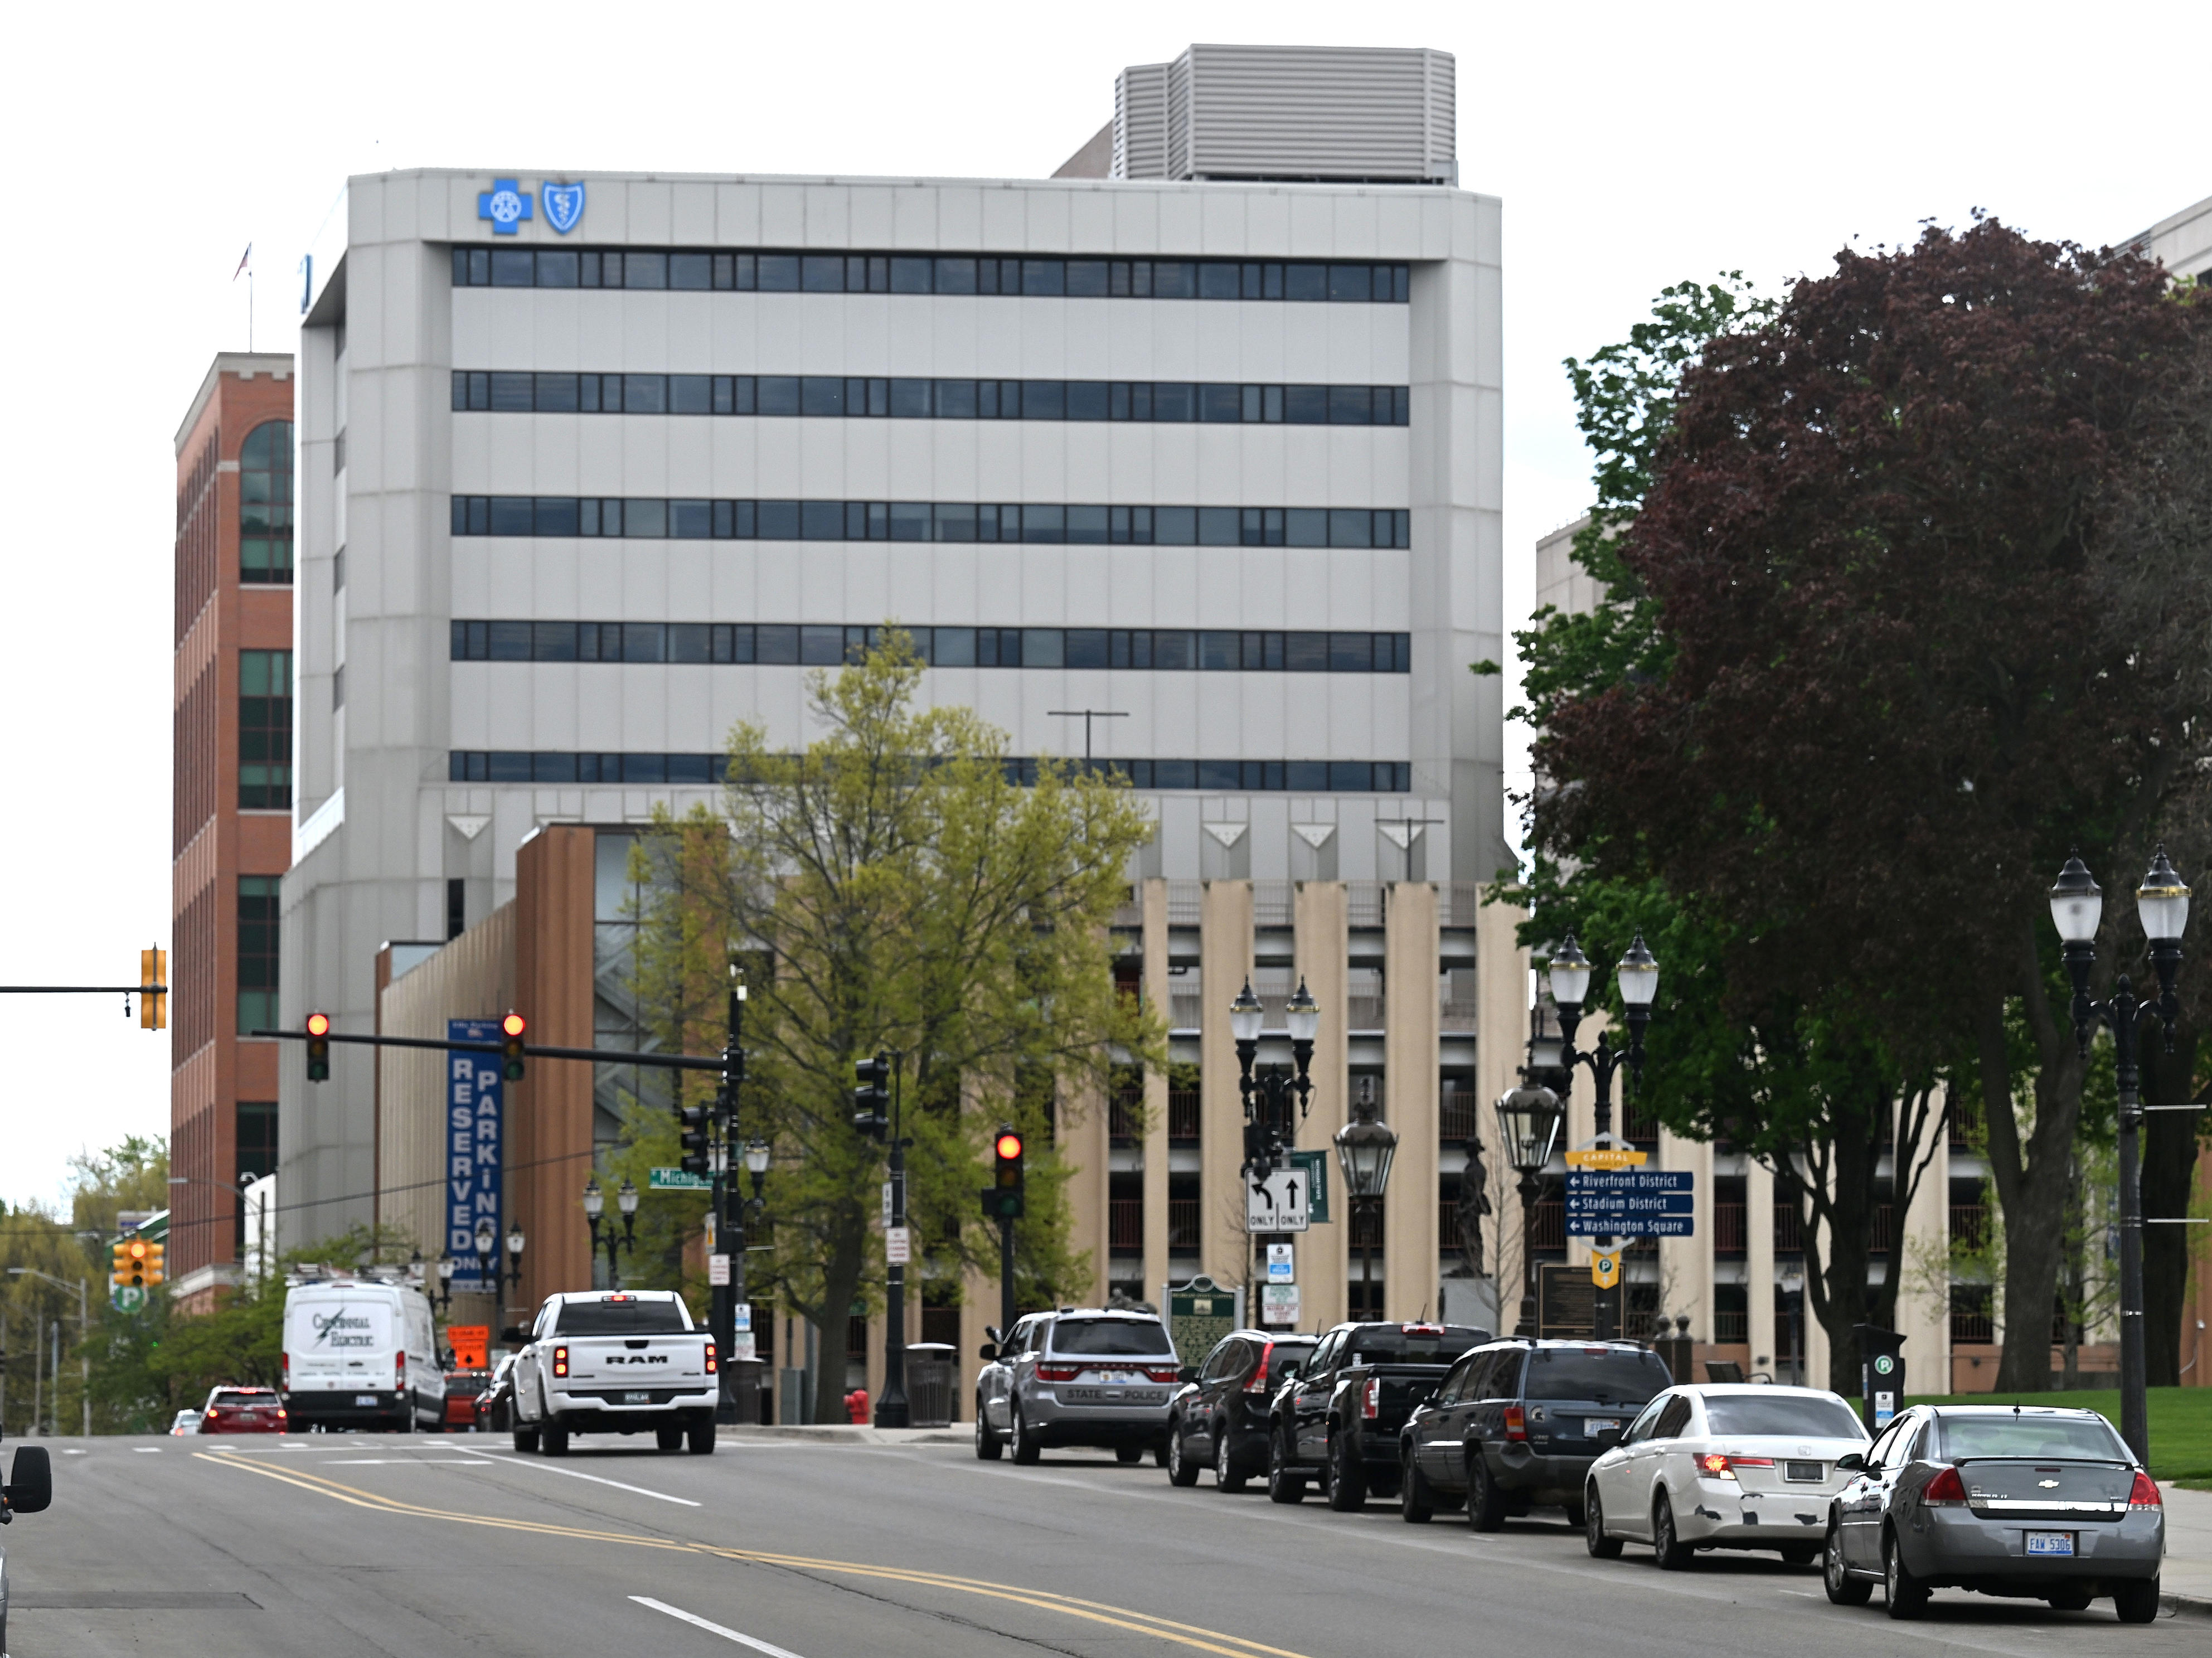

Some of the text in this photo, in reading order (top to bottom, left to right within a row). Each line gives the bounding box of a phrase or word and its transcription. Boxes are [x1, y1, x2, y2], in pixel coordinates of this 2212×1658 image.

[452, 1059, 473, 1250] RESERVED
[1583, 1174, 1677, 1187] Riverfront District
[1582, 1197, 1667, 1210] Stadium District
[1250, 1216, 1274, 1225] ONLY
[1281, 1216, 1304, 1225] ONLY
[1583, 1219, 1684, 1235] Washington Square
[1602, 1261, 1611, 1273] P
[1880, 1360, 1889, 1370] P
[1067, 1389, 1163, 1400] STATE POLICE
[2030, 1538, 2070, 1550] FAW 5306
